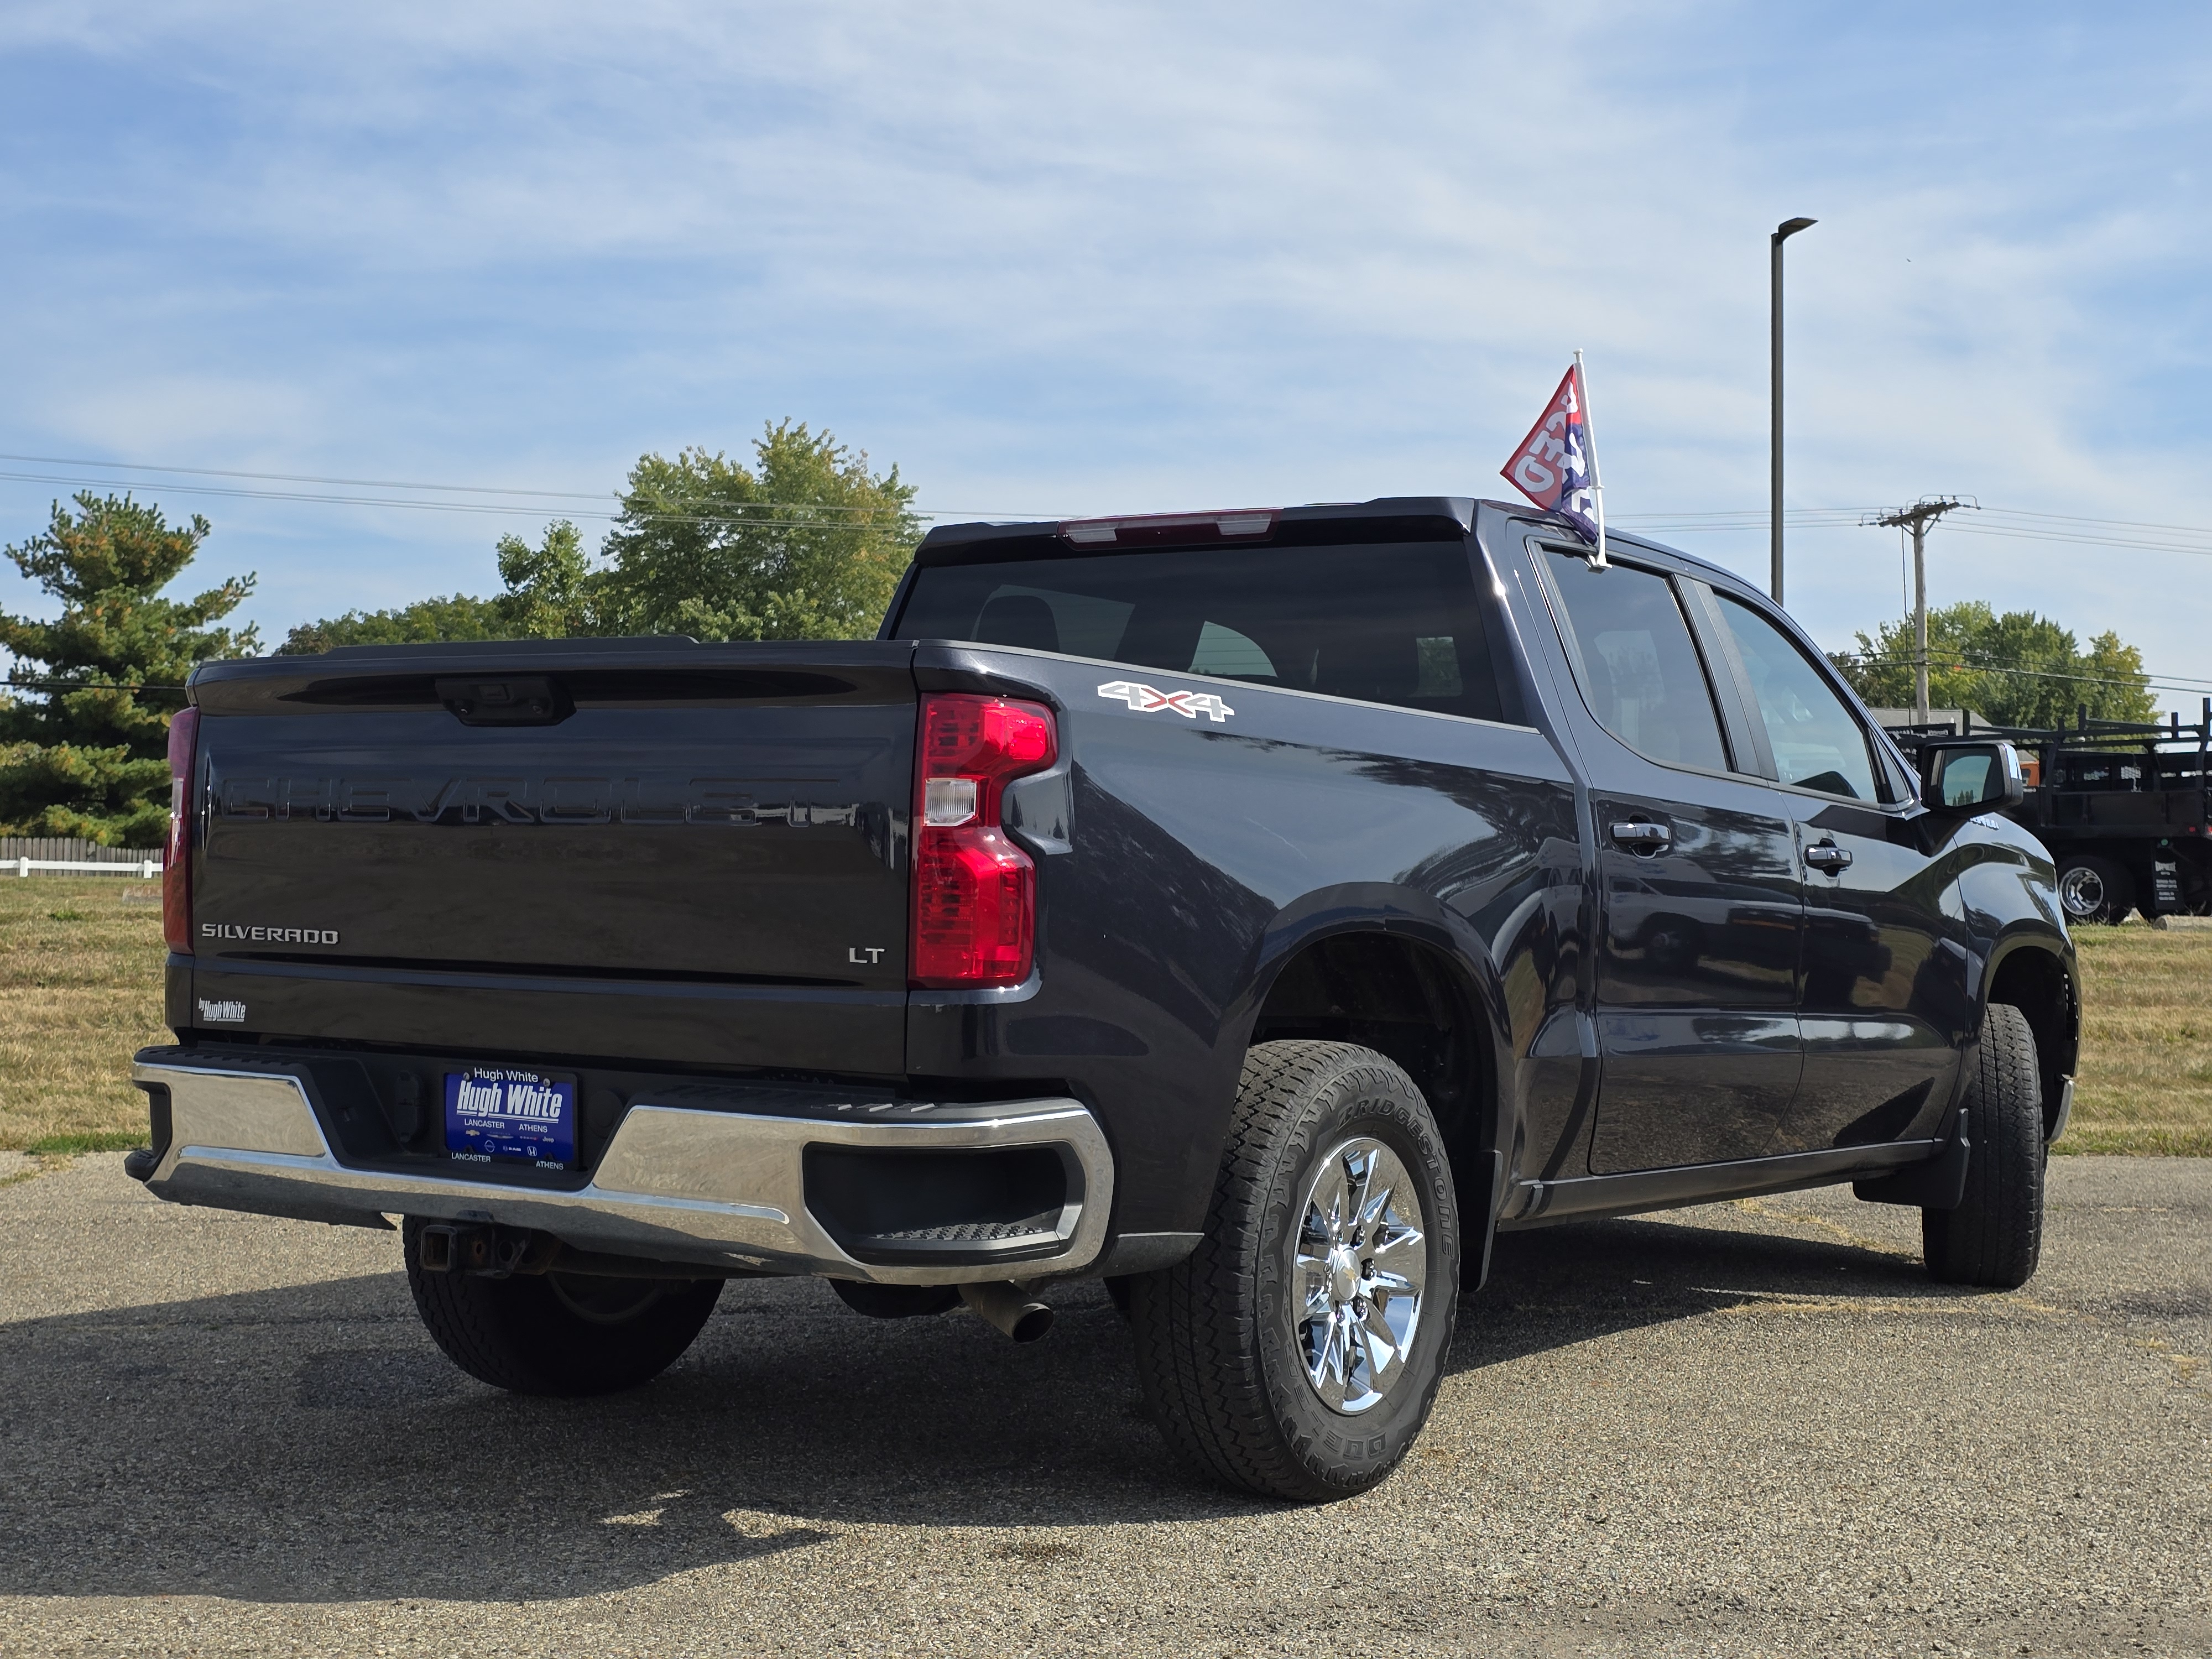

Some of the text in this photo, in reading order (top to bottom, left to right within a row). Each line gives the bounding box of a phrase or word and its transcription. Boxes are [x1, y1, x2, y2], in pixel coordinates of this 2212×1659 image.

[222, 777, 842, 828] CHEVROLET
[202, 923, 338, 945] SILVERADO
[849, 947, 885, 963] LT
[204, 1000, 222, 1021] Hugh
[223, 1001, 246, 1019] White
[474, 1067, 539, 1083] Hugh White
[457, 1080, 563, 1118] Hugh White
[464, 1118, 505, 1129] LANCASTER
[519, 1123, 548, 1133] ATHENS
[451, 1152, 564, 1171] LANCASTER ATHENS
[1335, 1096, 1454, 1259] BRIDGESTONE
[1284, 1339, 1387, 1460] DUELER
